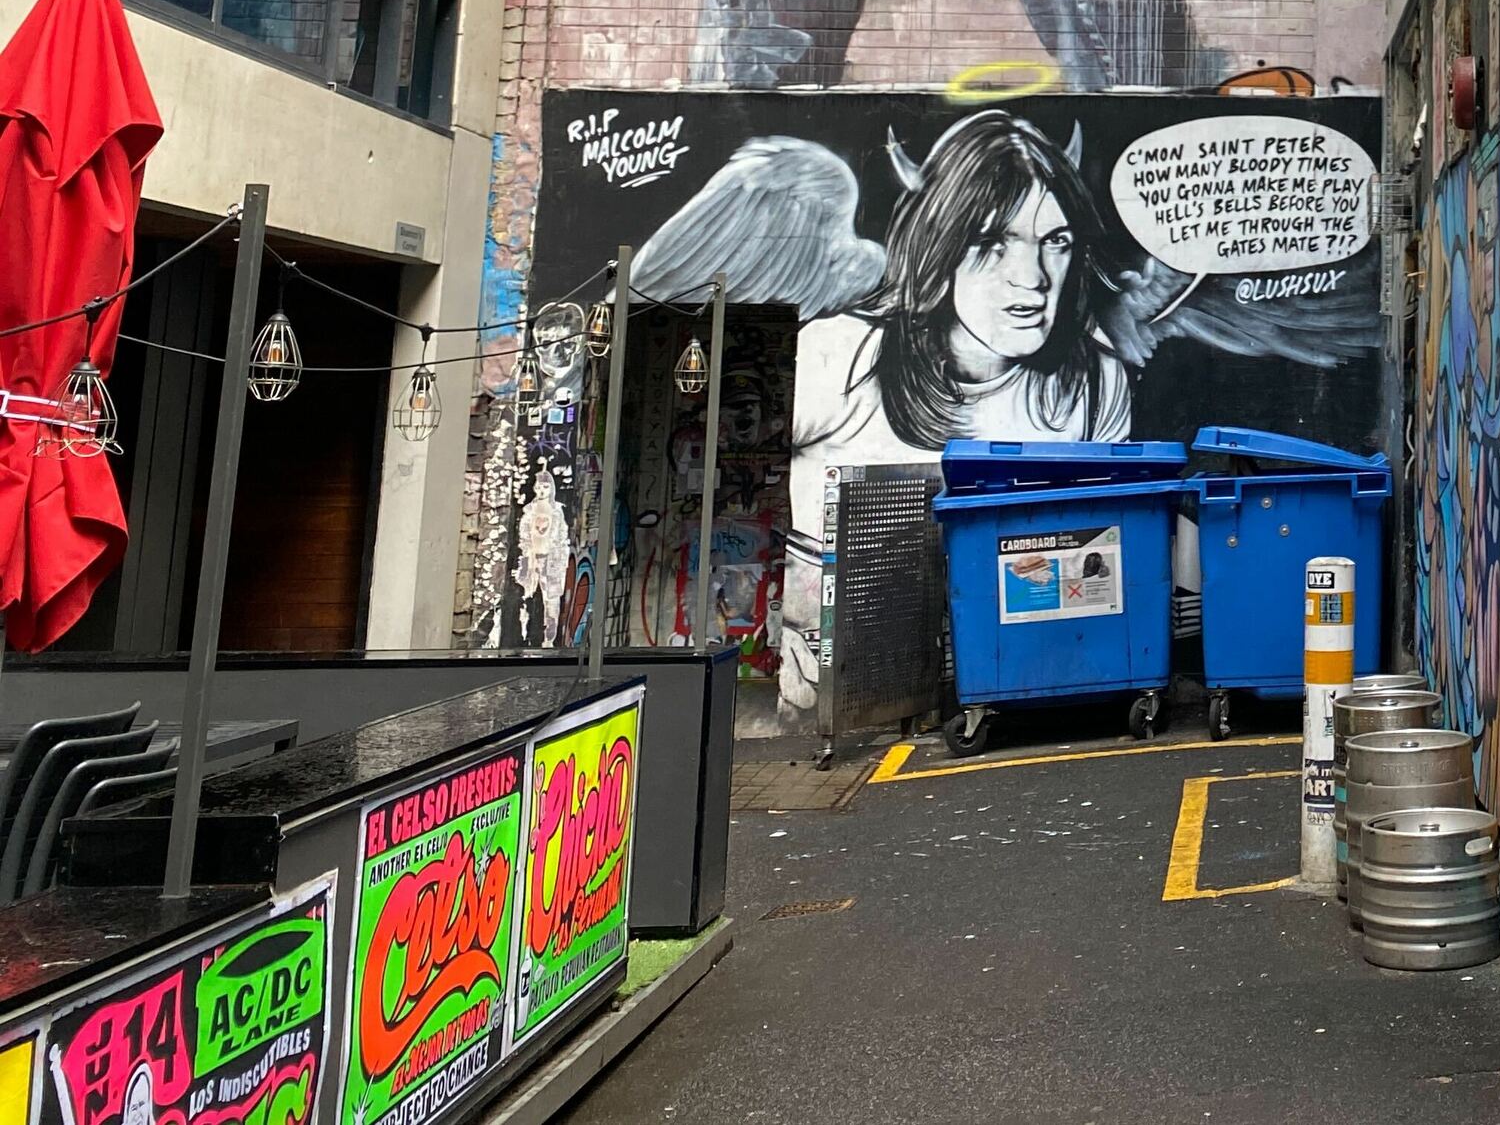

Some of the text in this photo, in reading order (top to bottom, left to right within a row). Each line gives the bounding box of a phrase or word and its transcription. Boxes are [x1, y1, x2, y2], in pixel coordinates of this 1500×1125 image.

[582, 116, 684, 167] MALCOLM
[1127, 136, 1325, 165] C'MON SAINT PETER
[602, 142, 690, 183] YOUNG
[1134, 157, 1352, 187] HOW MANY BLOODY TIMES
[1139, 176, 1365, 208] YOU GONNA MAKE ME PLAY
[1155, 195, 1360, 225] HELL'S BELLS BEFORE YOU
[1170, 216, 1355, 244] LET ME THROUGH THE
[1217, 238, 1266, 258] GATES
[1272, 236, 1320, 253] MATE
[1235, 270, 1346, 303] @LUSHSUX
[1001, 536, 1056, 551] CARDBOARD
[367, 756, 519, 858] EL CELSO PRESENTS:
[369, 849, 411, 887] ANOTHER
[414, 844, 424, 863] EL
[208, 956, 312, 1044] AC/DC
[123, 986, 178, 1084] 14
[218, 1003, 302, 1060] LANE
[188, 1084, 214, 1121] LOS
[219, 1028, 311, 1102] INDISCUTIBLES
[432, 1075, 445, 1109] TO
[448, 1041, 488, 1092] CHANGE
